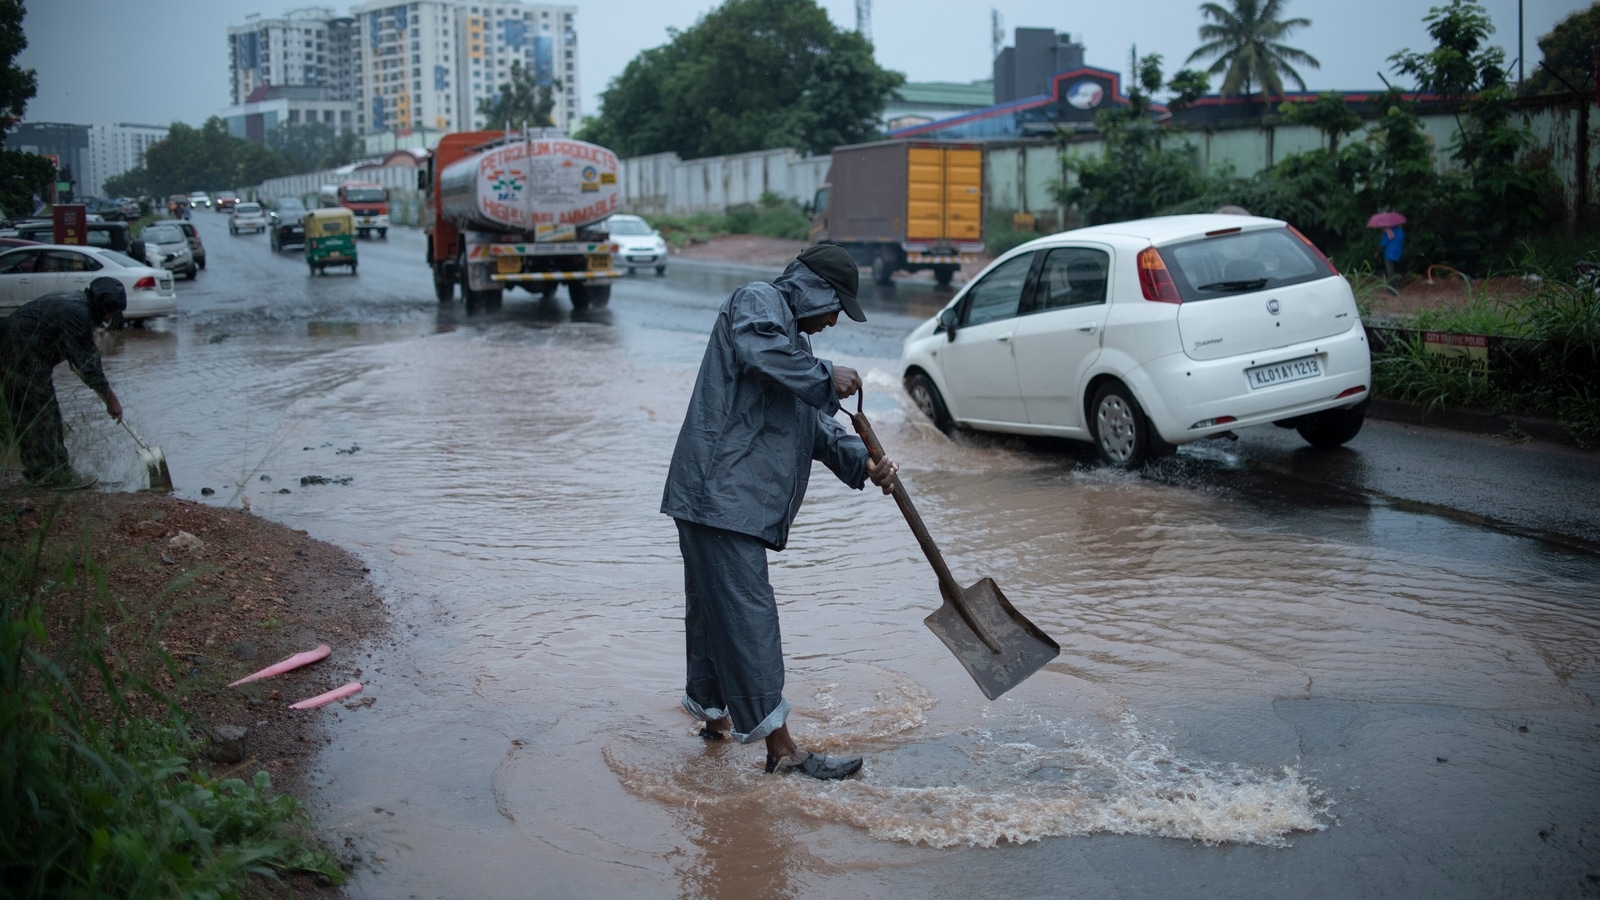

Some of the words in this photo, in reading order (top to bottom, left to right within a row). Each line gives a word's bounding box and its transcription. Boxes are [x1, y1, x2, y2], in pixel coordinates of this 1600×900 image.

[481, 142, 550, 175] PETROLEUM
[553, 141, 617, 172] PRODUCTS
[1427, 333, 1440, 342] CITY
[1441, 334, 1464, 345] TRAFFIC
[1465, 336, 1485, 346] POLICE
